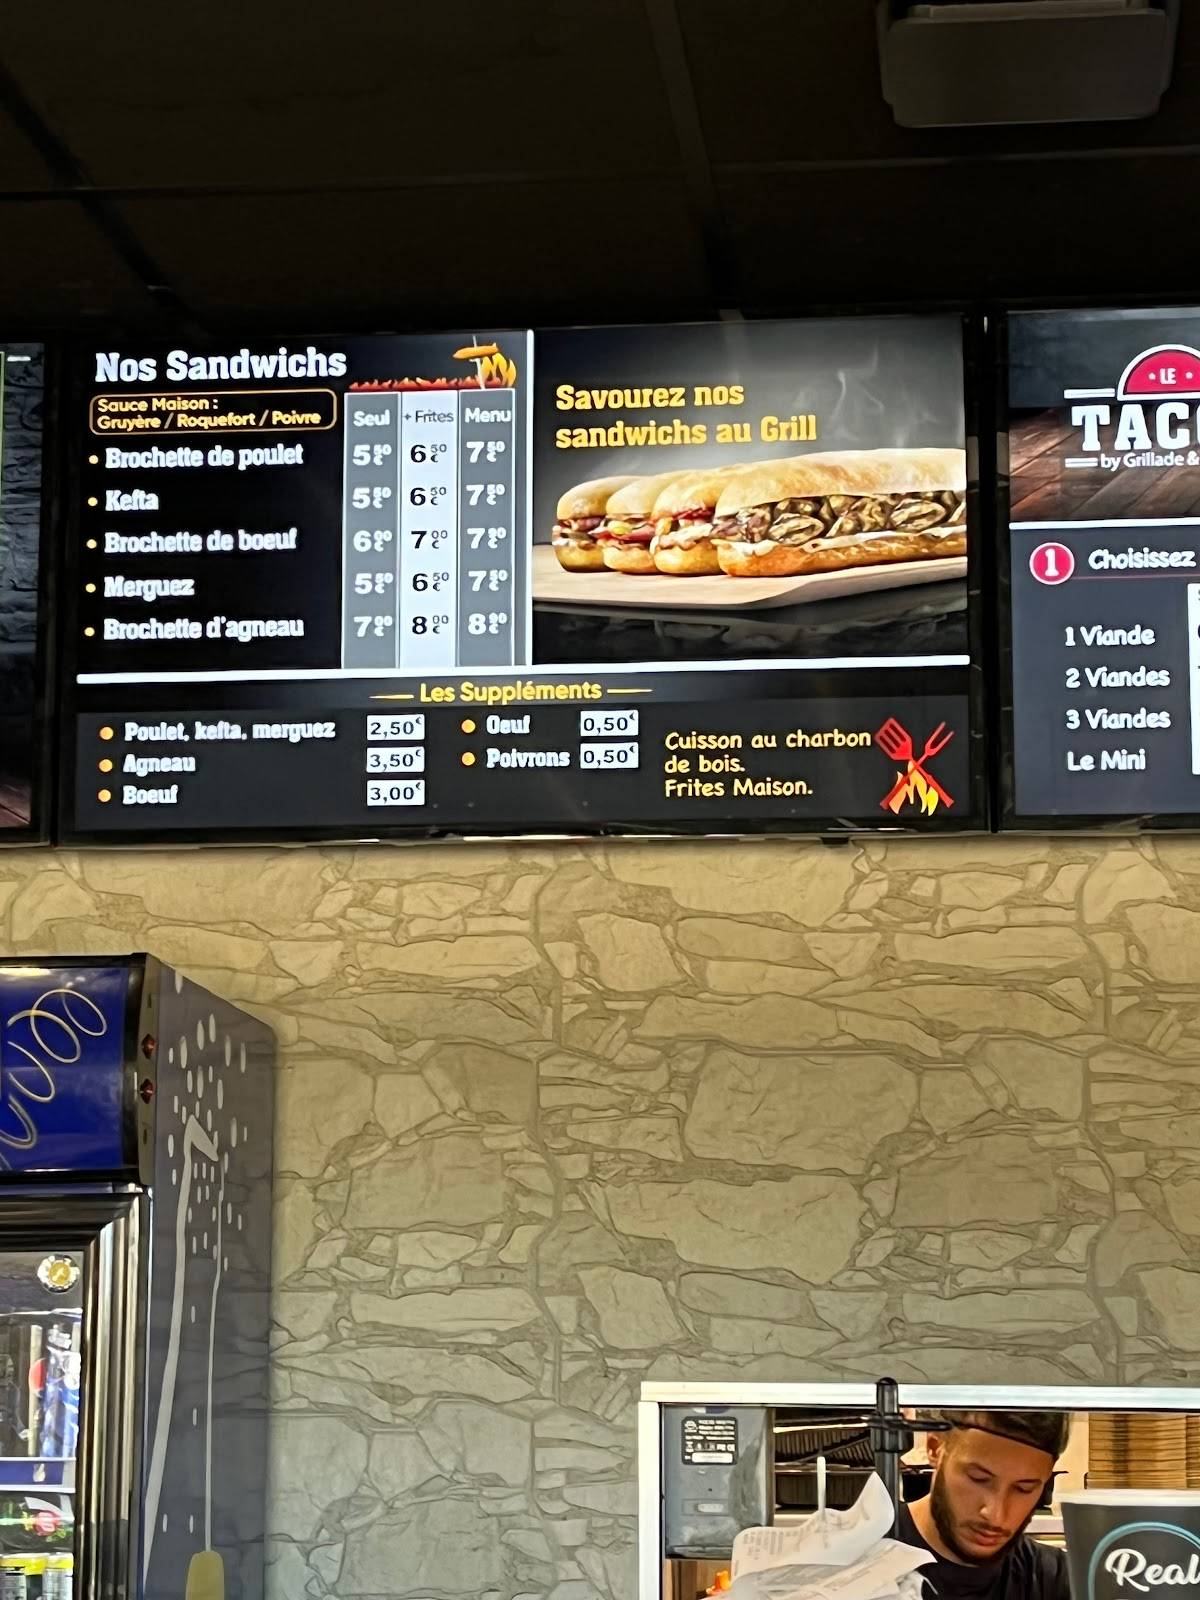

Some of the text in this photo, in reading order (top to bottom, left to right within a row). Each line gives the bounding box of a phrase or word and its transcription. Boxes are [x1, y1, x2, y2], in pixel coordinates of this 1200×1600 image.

[95, 347, 347, 383] Nos Sandwichs
[1160, 368, 1177, 384] LE
[97, 398, 148, 412] Sauce
[152, 397, 209, 410] Maison
[556, 384, 744, 411] Savourez nos
[97, 415, 161, 431] Gruyère
[177, 412, 255, 429] Roquefort
[272, 410, 321, 425] Poivre
[353, 409, 390, 427] Seul
[415, 410, 454, 423] Frites
[465, 407, 512, 423] Menu
[555, 415, 817, 448] sandwichs au Grill
[1071, 402, 1200, 451] TAC
[105, 443, 303, 470] Brochette de poulet
[1101, 453, 1120, 472] by
[1123, 451, 1184, 467] Grillade
[105, 489, 159, 511] Kefta
[104, 526, 299, 553] Brochette de boeuf
[1044, 550, 1060, 577] 1
[1088, 549, 1195, 570] Choisissez
[104, 575, 195, 601] Merguez
[103, 618, 202, 640] Brochette
[1065, 625, 1155, 646] 1 Viande
[1065, 666, 1171, 689] 2 Viandes
[420, 681, 602, 705] Les Suppléments
[486, 715, 531, 735] Oeuf
[1066, 708, 1171, 730] 3 Viandes
[252, 721, 336, 743] merguez
[665, 729, 872, 750] Cuisson au charbon
[123, 754, 196, 777] Agneau
[486, 747, 571, 769] Poivrons
[664, 755, 745, 774] de bois.
[1067, 749, 1146, 772] Le Mini
[123, 784, 178, 805] Boeuf
[664, 777, 813, 798] Frites Maison.
